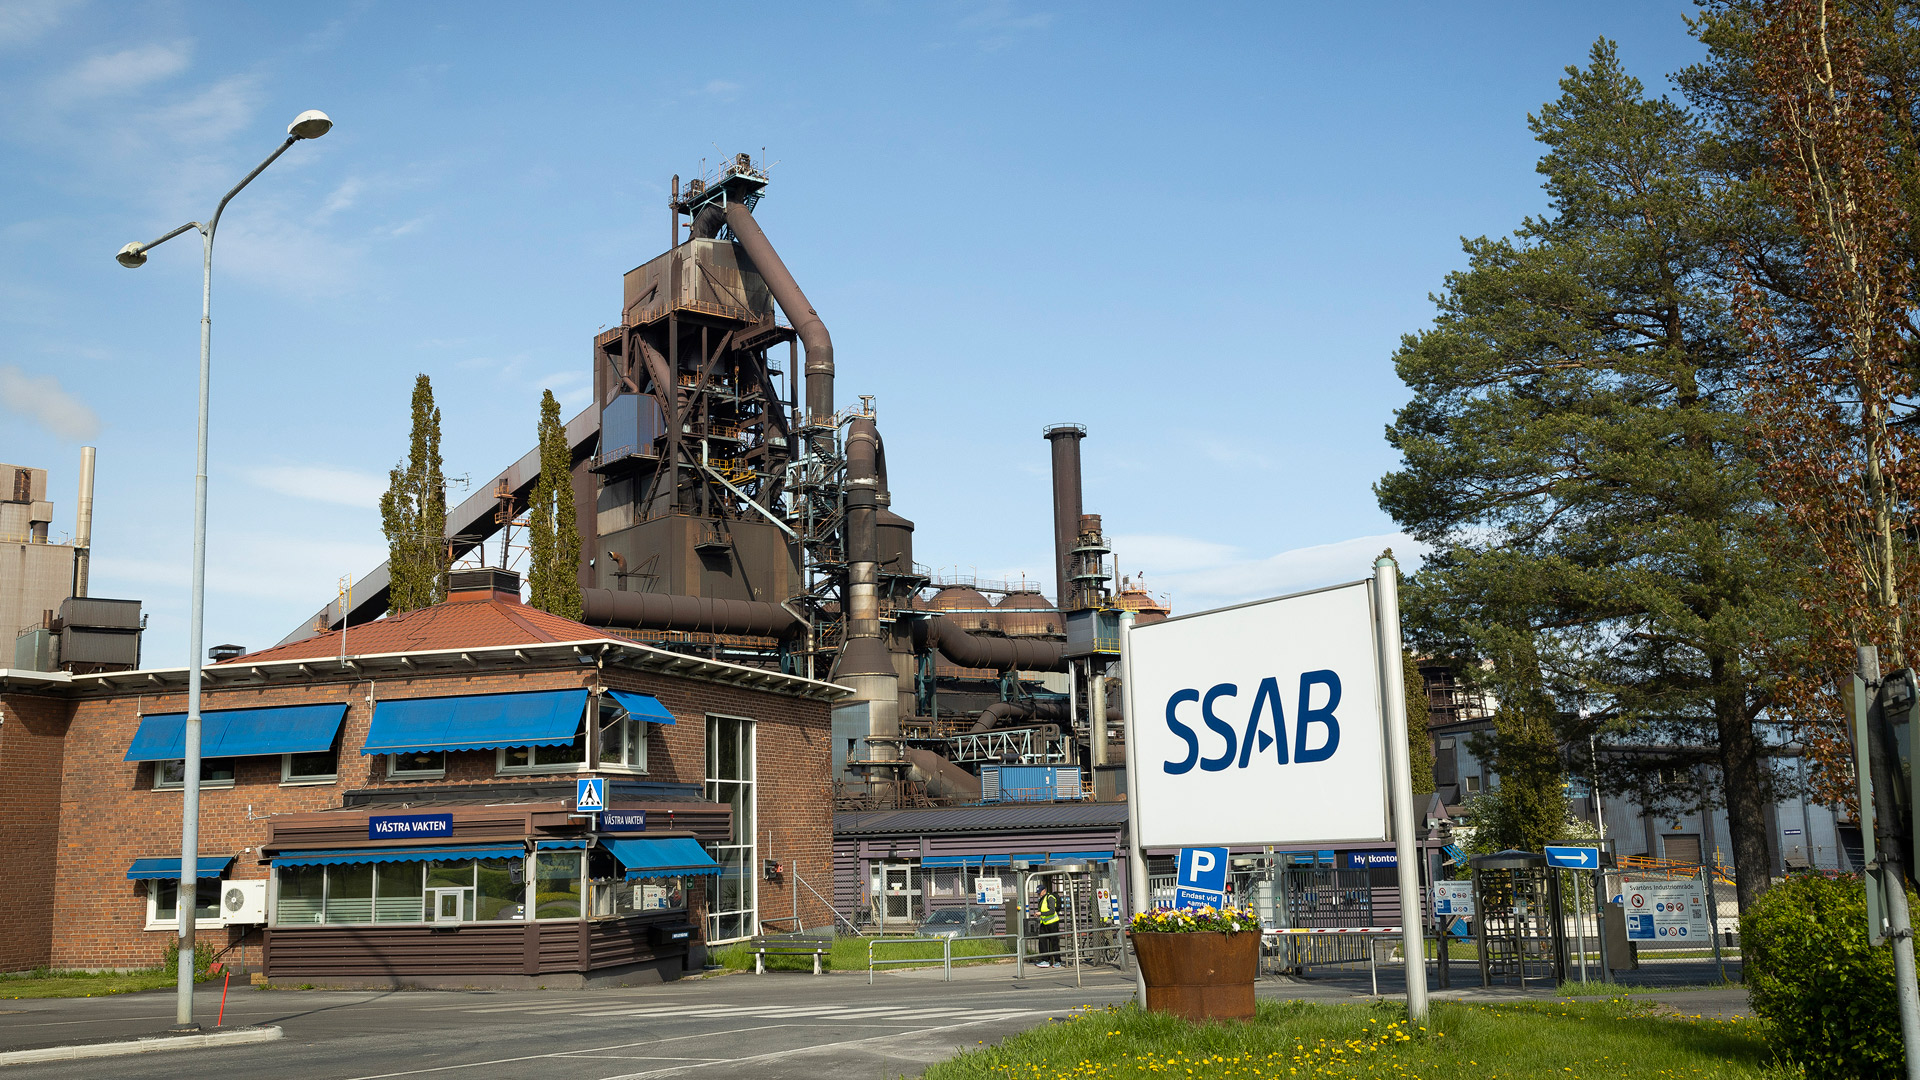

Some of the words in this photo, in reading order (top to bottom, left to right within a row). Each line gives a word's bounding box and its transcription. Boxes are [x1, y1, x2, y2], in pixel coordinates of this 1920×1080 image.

[1163, 669, 1342, 775] SSAB
[604, 813, 624, 825] VÄSTRA
[625, 815, 643, 825] VAKTEN
[376, 821, 410, 833] VÄSTRA
[412, 821, 446, 832] VAKTEN
[1190, 850, 1216, 882] P
[1181, 891, 1205, 900] Endast
